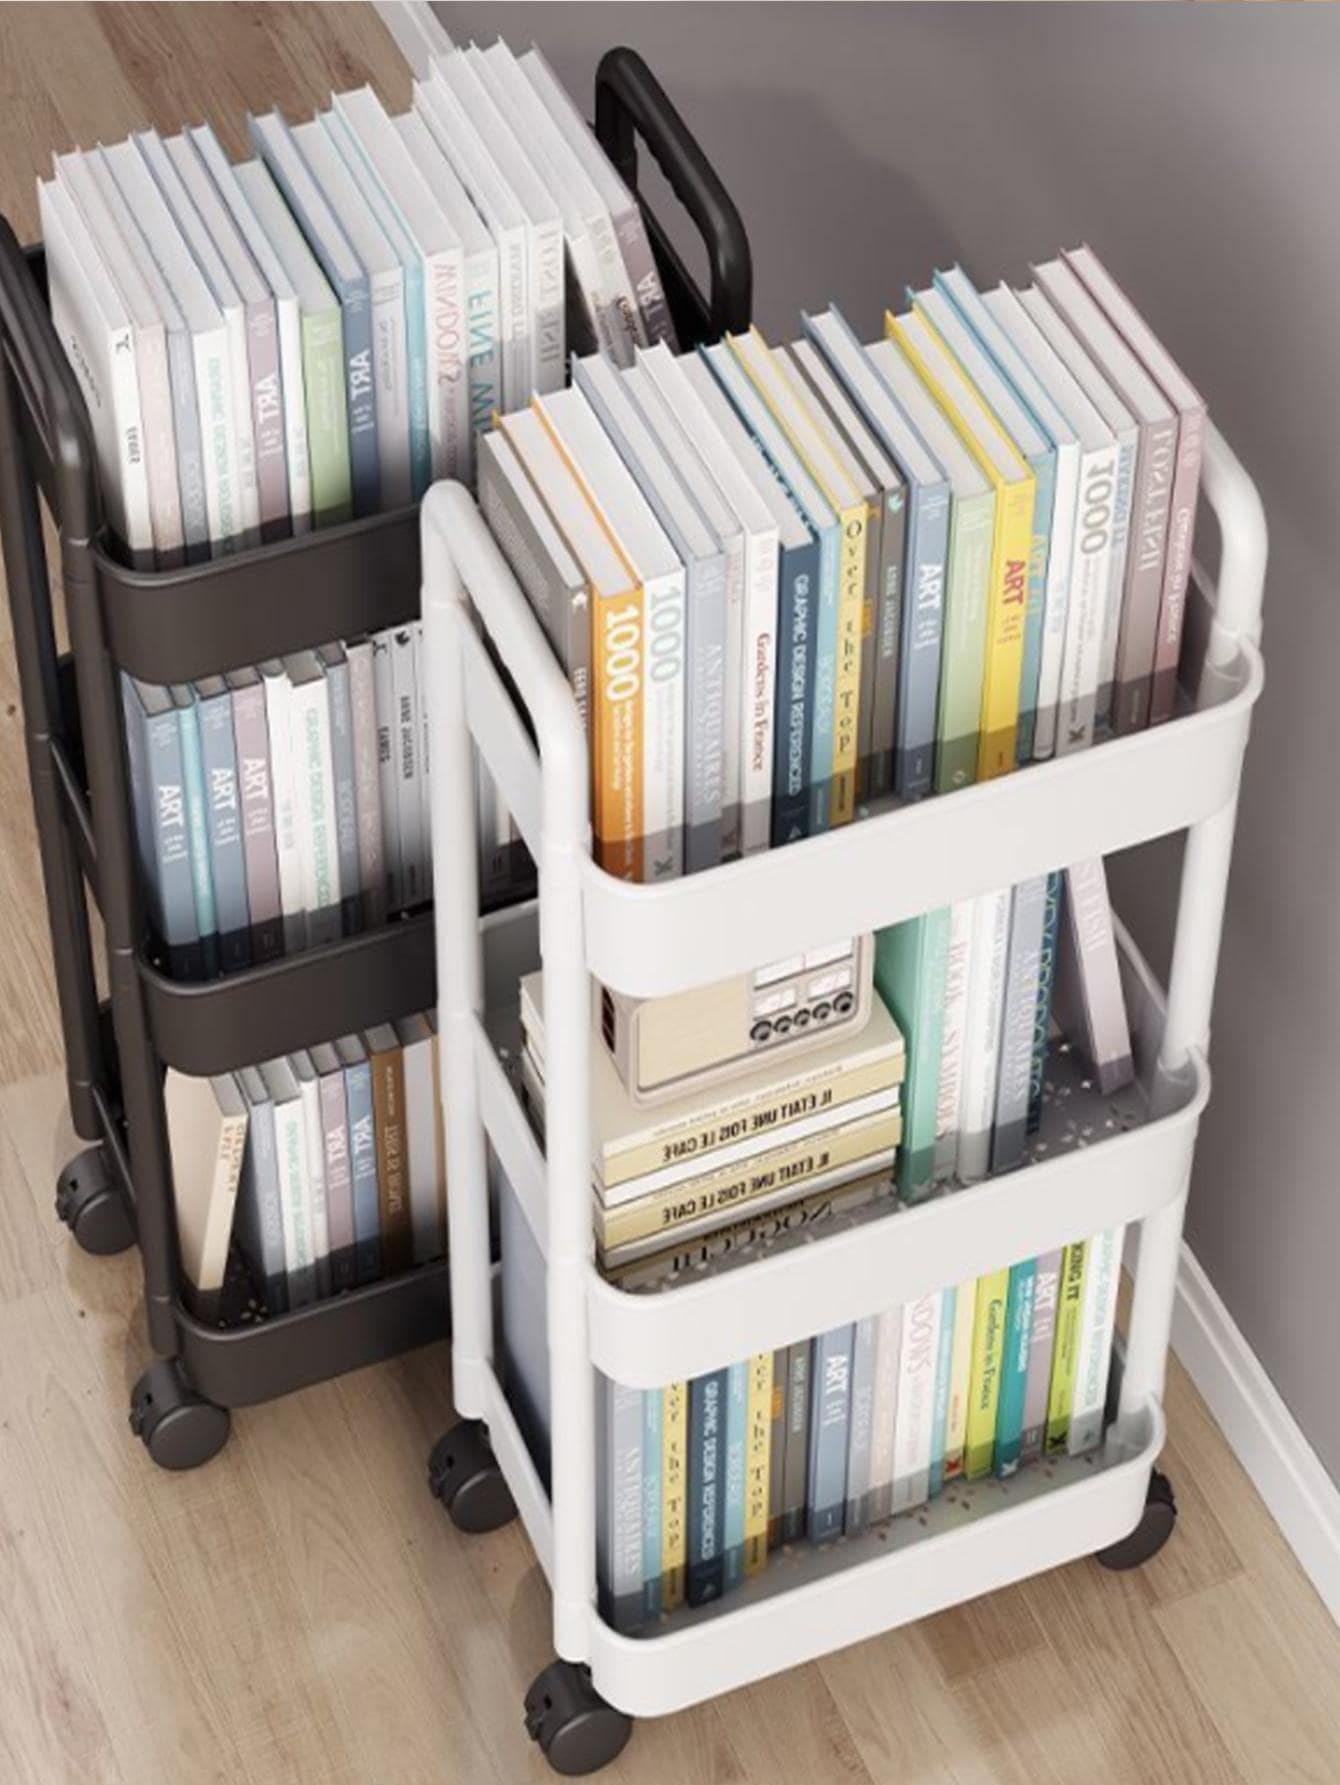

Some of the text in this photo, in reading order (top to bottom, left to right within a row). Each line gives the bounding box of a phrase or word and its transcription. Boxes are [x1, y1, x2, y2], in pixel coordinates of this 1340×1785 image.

[917, 563, 942, 611] ART
[1002, 559, 1026, 606] ART
[605, 603, 640, 702] 1000
[650, 584, 682, 683] 1000
[752, 633, 771, 772] Gardens in France
[788, 574, 810, 795] GRAPHIC DESIGN REFERENCES
[400, 695, 413, 723] ARNE
[704, 643, 723, 804] ANTIQUAIRES
[377, 726, 390, 763] EAMES
[211, 768, 236, 811] ART
[243, 757, 268, 802] ART
[157, 784, 184, 828] ART
[1034, 1272, 1058, 1311] ART
[825, 1354, 848, 1395] ART
[701, 1381, 719, 1561] GRAPHIC DESIGN REFERENCES
